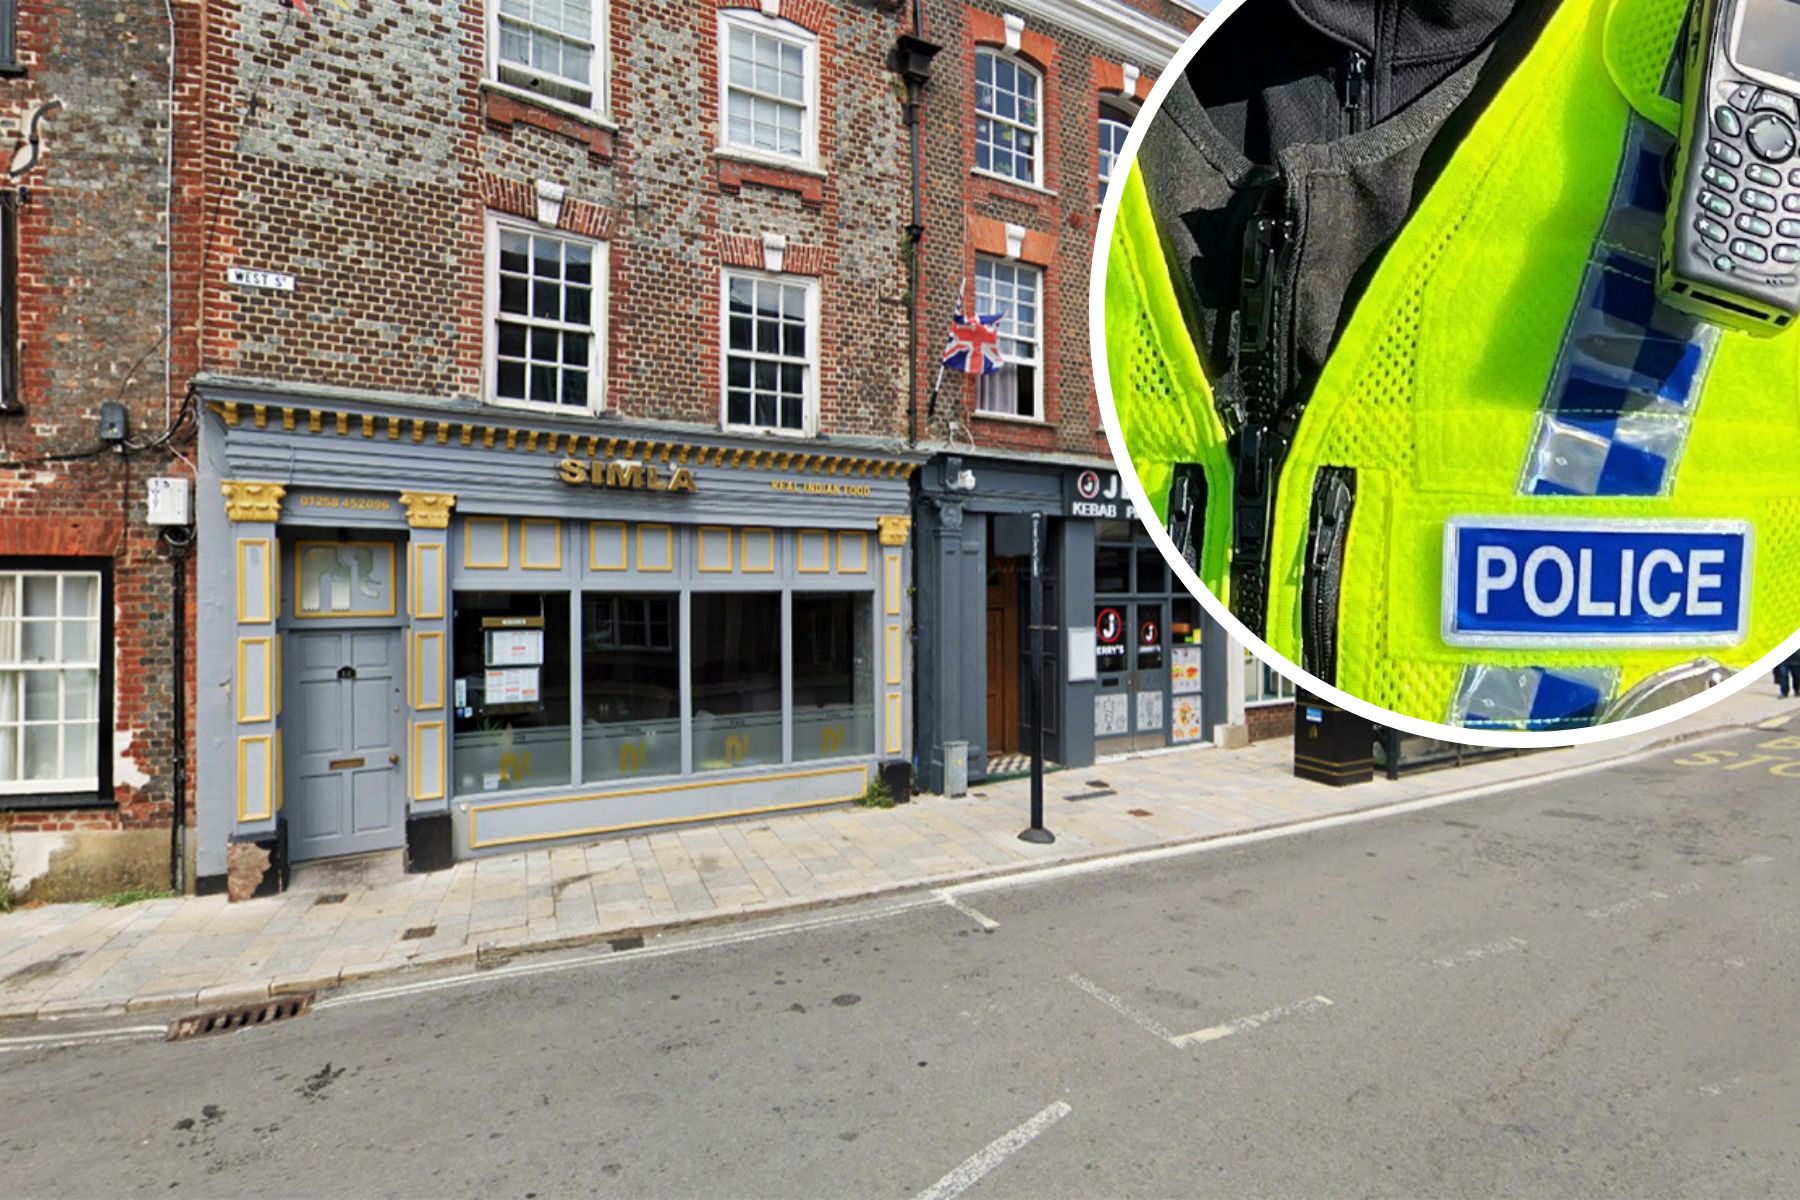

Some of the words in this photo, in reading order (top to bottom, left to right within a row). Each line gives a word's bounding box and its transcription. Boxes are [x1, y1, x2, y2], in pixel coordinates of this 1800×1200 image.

[1714, 142, 1721, 154] 1
[1706, 166, 1715, 178] 4
[1751, 165, 1760, 178] 2
[1703, 191, 1712, 203] 7
[1746, 190, 1756, 203] 5
[1741, 215, 1750, 228] 8
[235, 270, 268, 285] WEST
[560, 458, 697, 493] SIMLA
[770, 480, 797, 493] REAL
[803, 482, 839, 494] INDIAN
[844, 485, 871, 496] FOOD
[1072, 501, 1117, 517] KEBAB
[1475, 545, 1725, 617] POLICE
